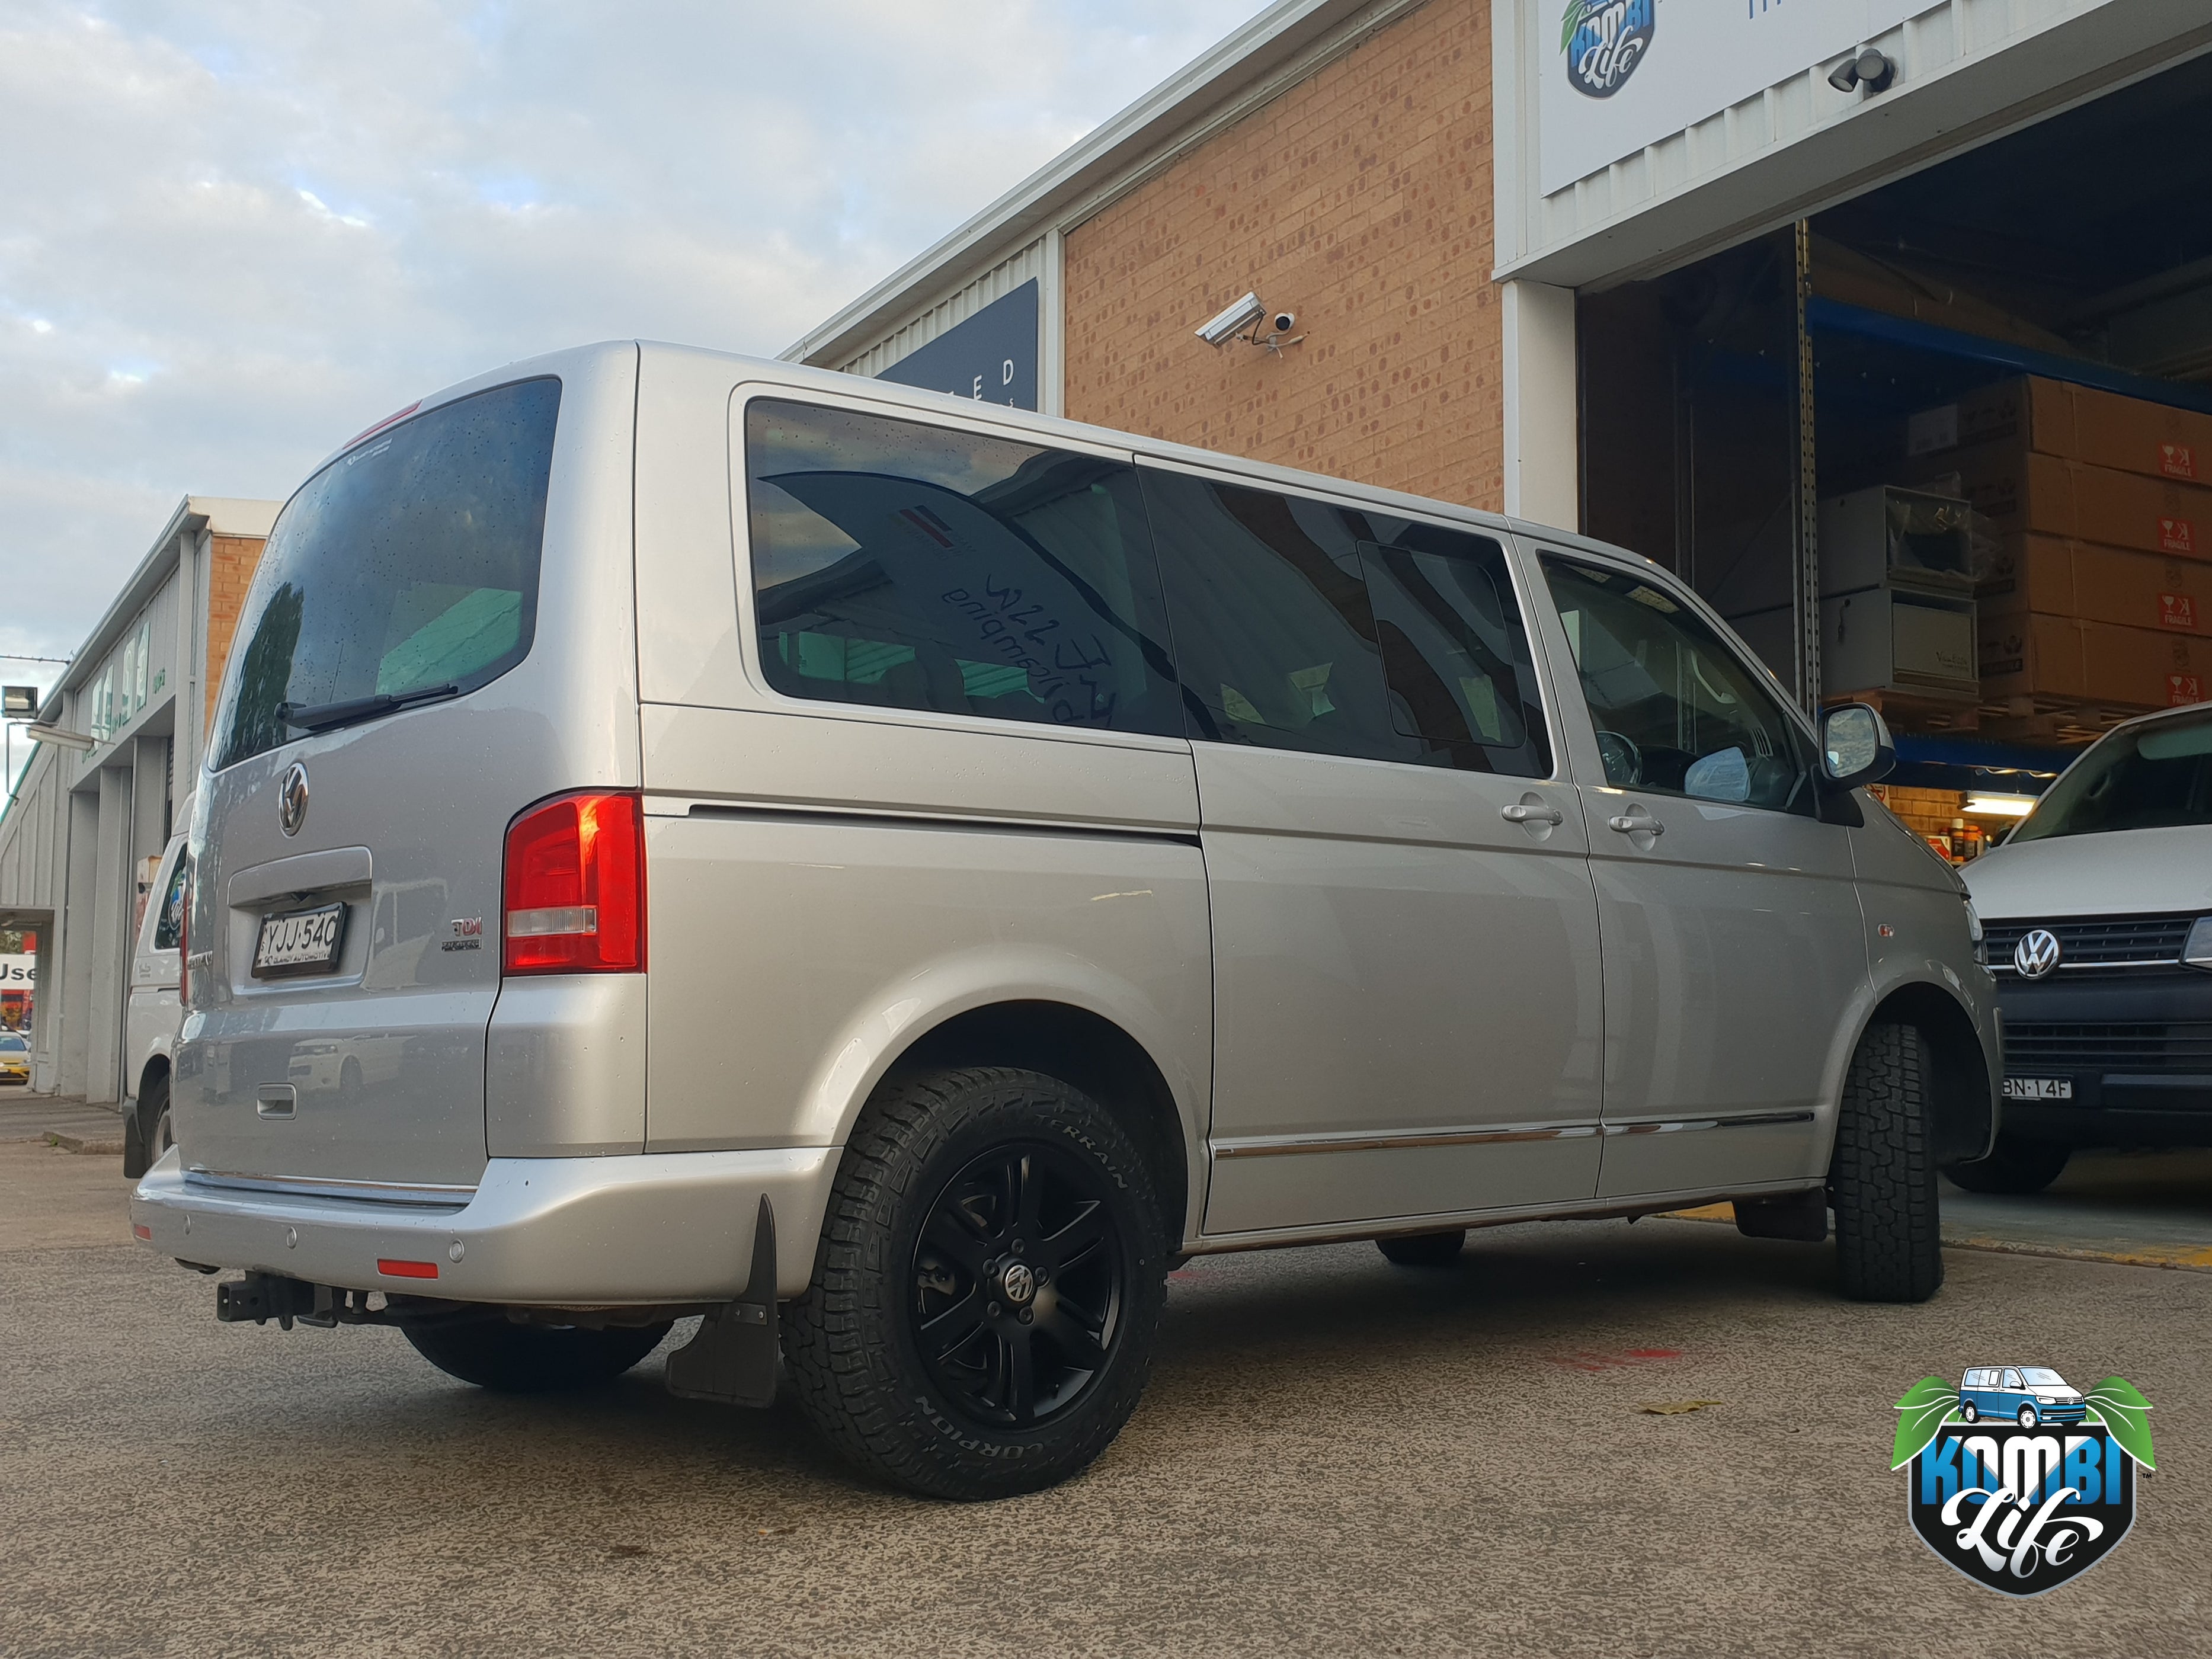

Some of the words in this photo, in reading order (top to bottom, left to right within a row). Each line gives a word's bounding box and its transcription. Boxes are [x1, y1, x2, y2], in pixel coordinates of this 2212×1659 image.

[1578, 25, 1644, 89] Life
[2164, 464, 2192, 476] FRAGILE
[2163, 538, 2191, 551] FRAGILE
[2165, 614, 2192, 626] FRAGILE
[451, 917, 482, 937] TDI
[915, 1395, 1061, 1460] CORPION
